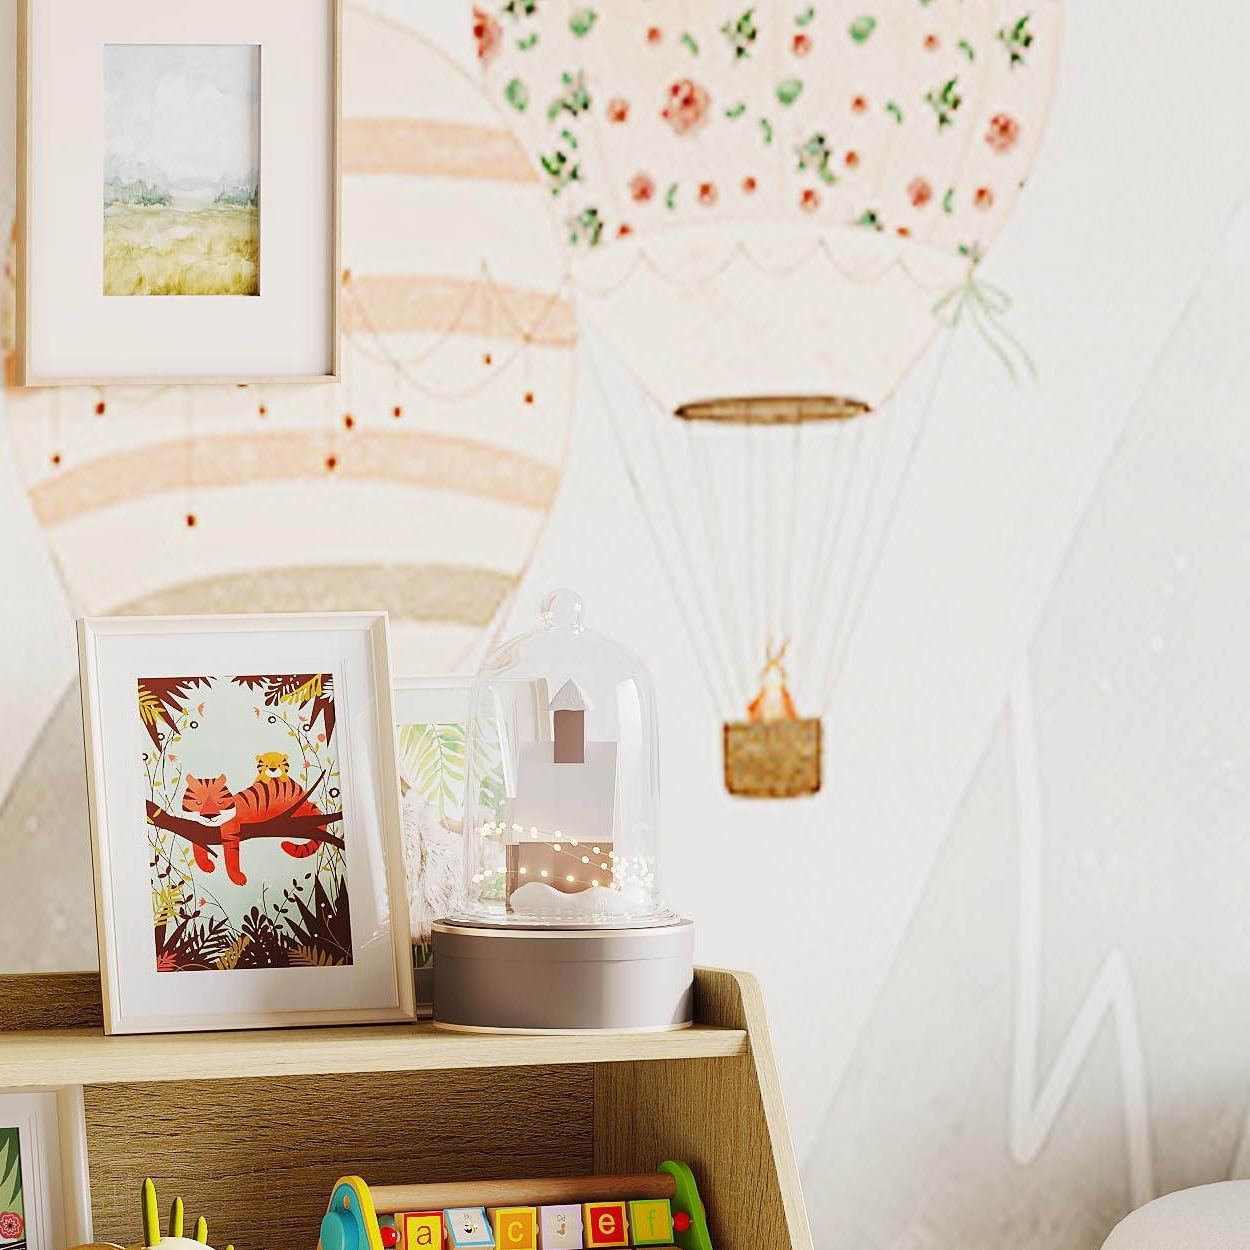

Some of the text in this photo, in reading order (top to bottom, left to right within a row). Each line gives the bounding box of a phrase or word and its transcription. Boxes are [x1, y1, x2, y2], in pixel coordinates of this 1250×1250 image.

[416, 1225, 432, 1246] a
[507, 1221, 524, 1243] c
[598, 1213, 616, 1235] e
[647, 1208, 656, 1236] f
